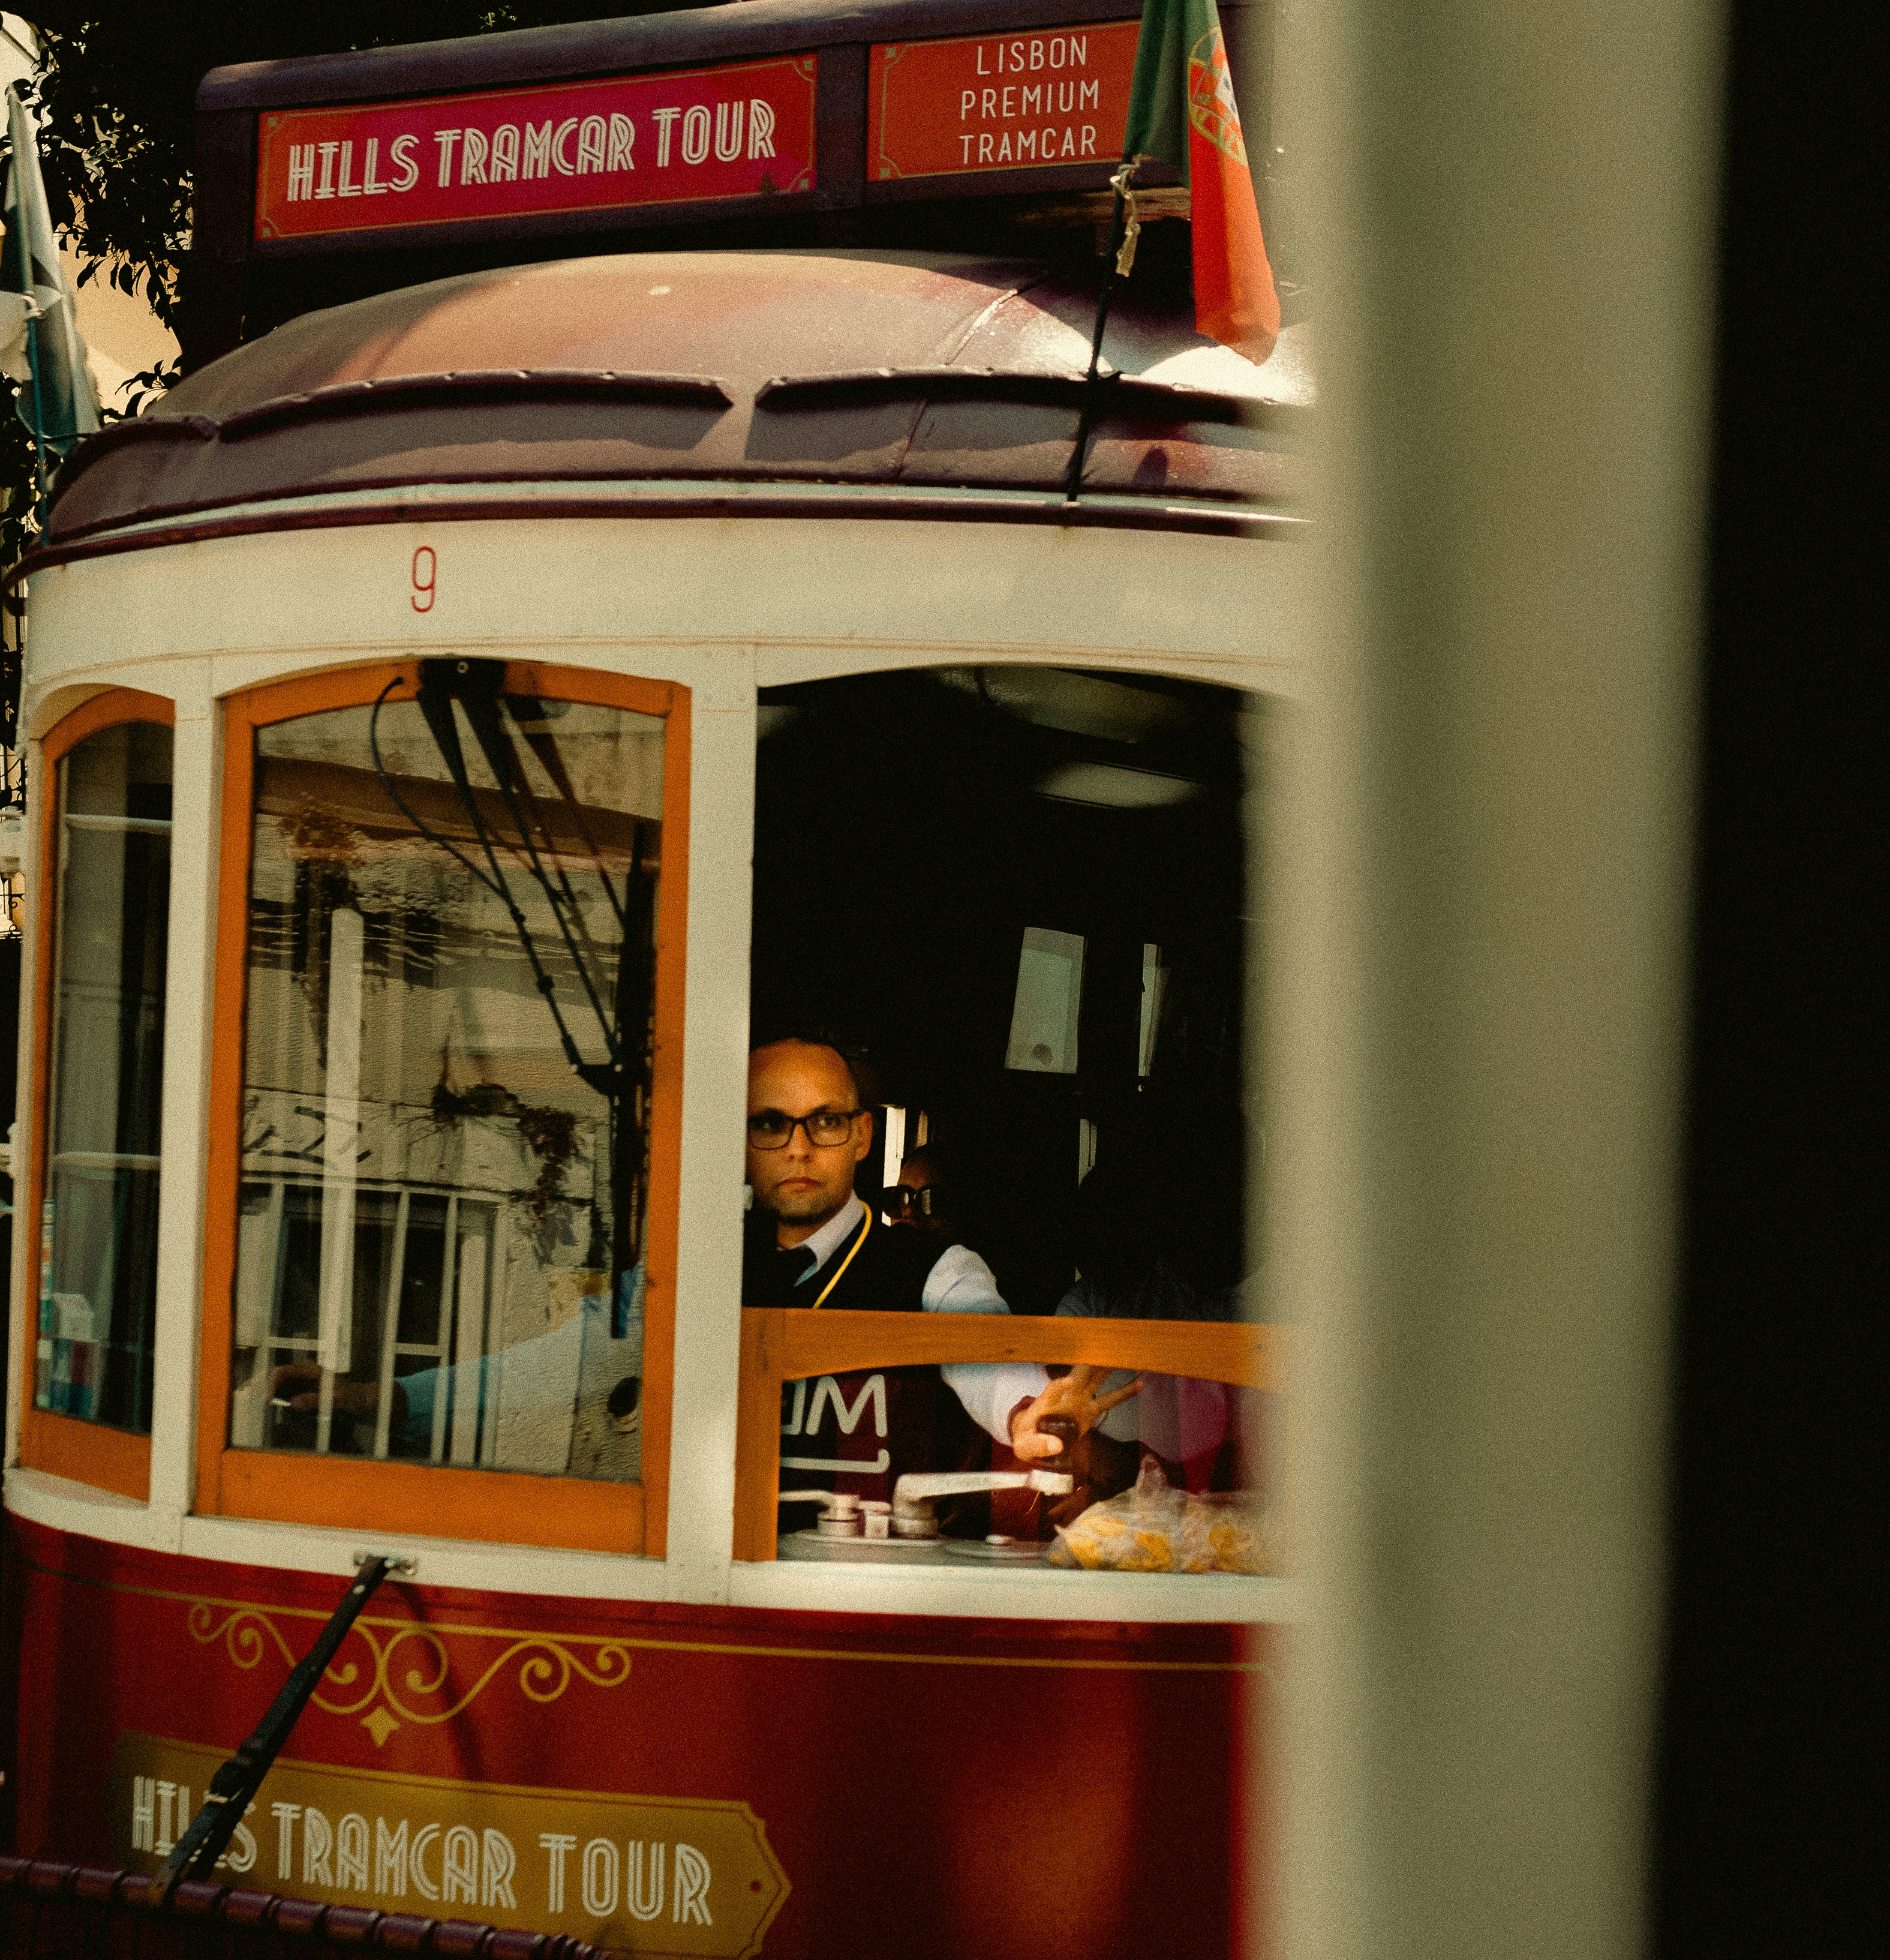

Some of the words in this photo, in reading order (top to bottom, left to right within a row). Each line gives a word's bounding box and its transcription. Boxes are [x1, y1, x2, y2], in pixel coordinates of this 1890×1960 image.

[976, 35, 1087, 76] LISBON
[960, 79, 1099, 121] PREMIUM
[286, 133, 420, 202] HILLS
[433, 112, 636, 188] TRAMCAR
[651, 98, 777, 168] TOUR
[959, 124, 1097, 164] TRAMCAR
[410, 545, 437, 614] 9
[131, 1775, 258, 1872] HILS
[271, 1800, 518, 1910] TRAMCAR
[539, 1832, 713, 1926] TOUR
